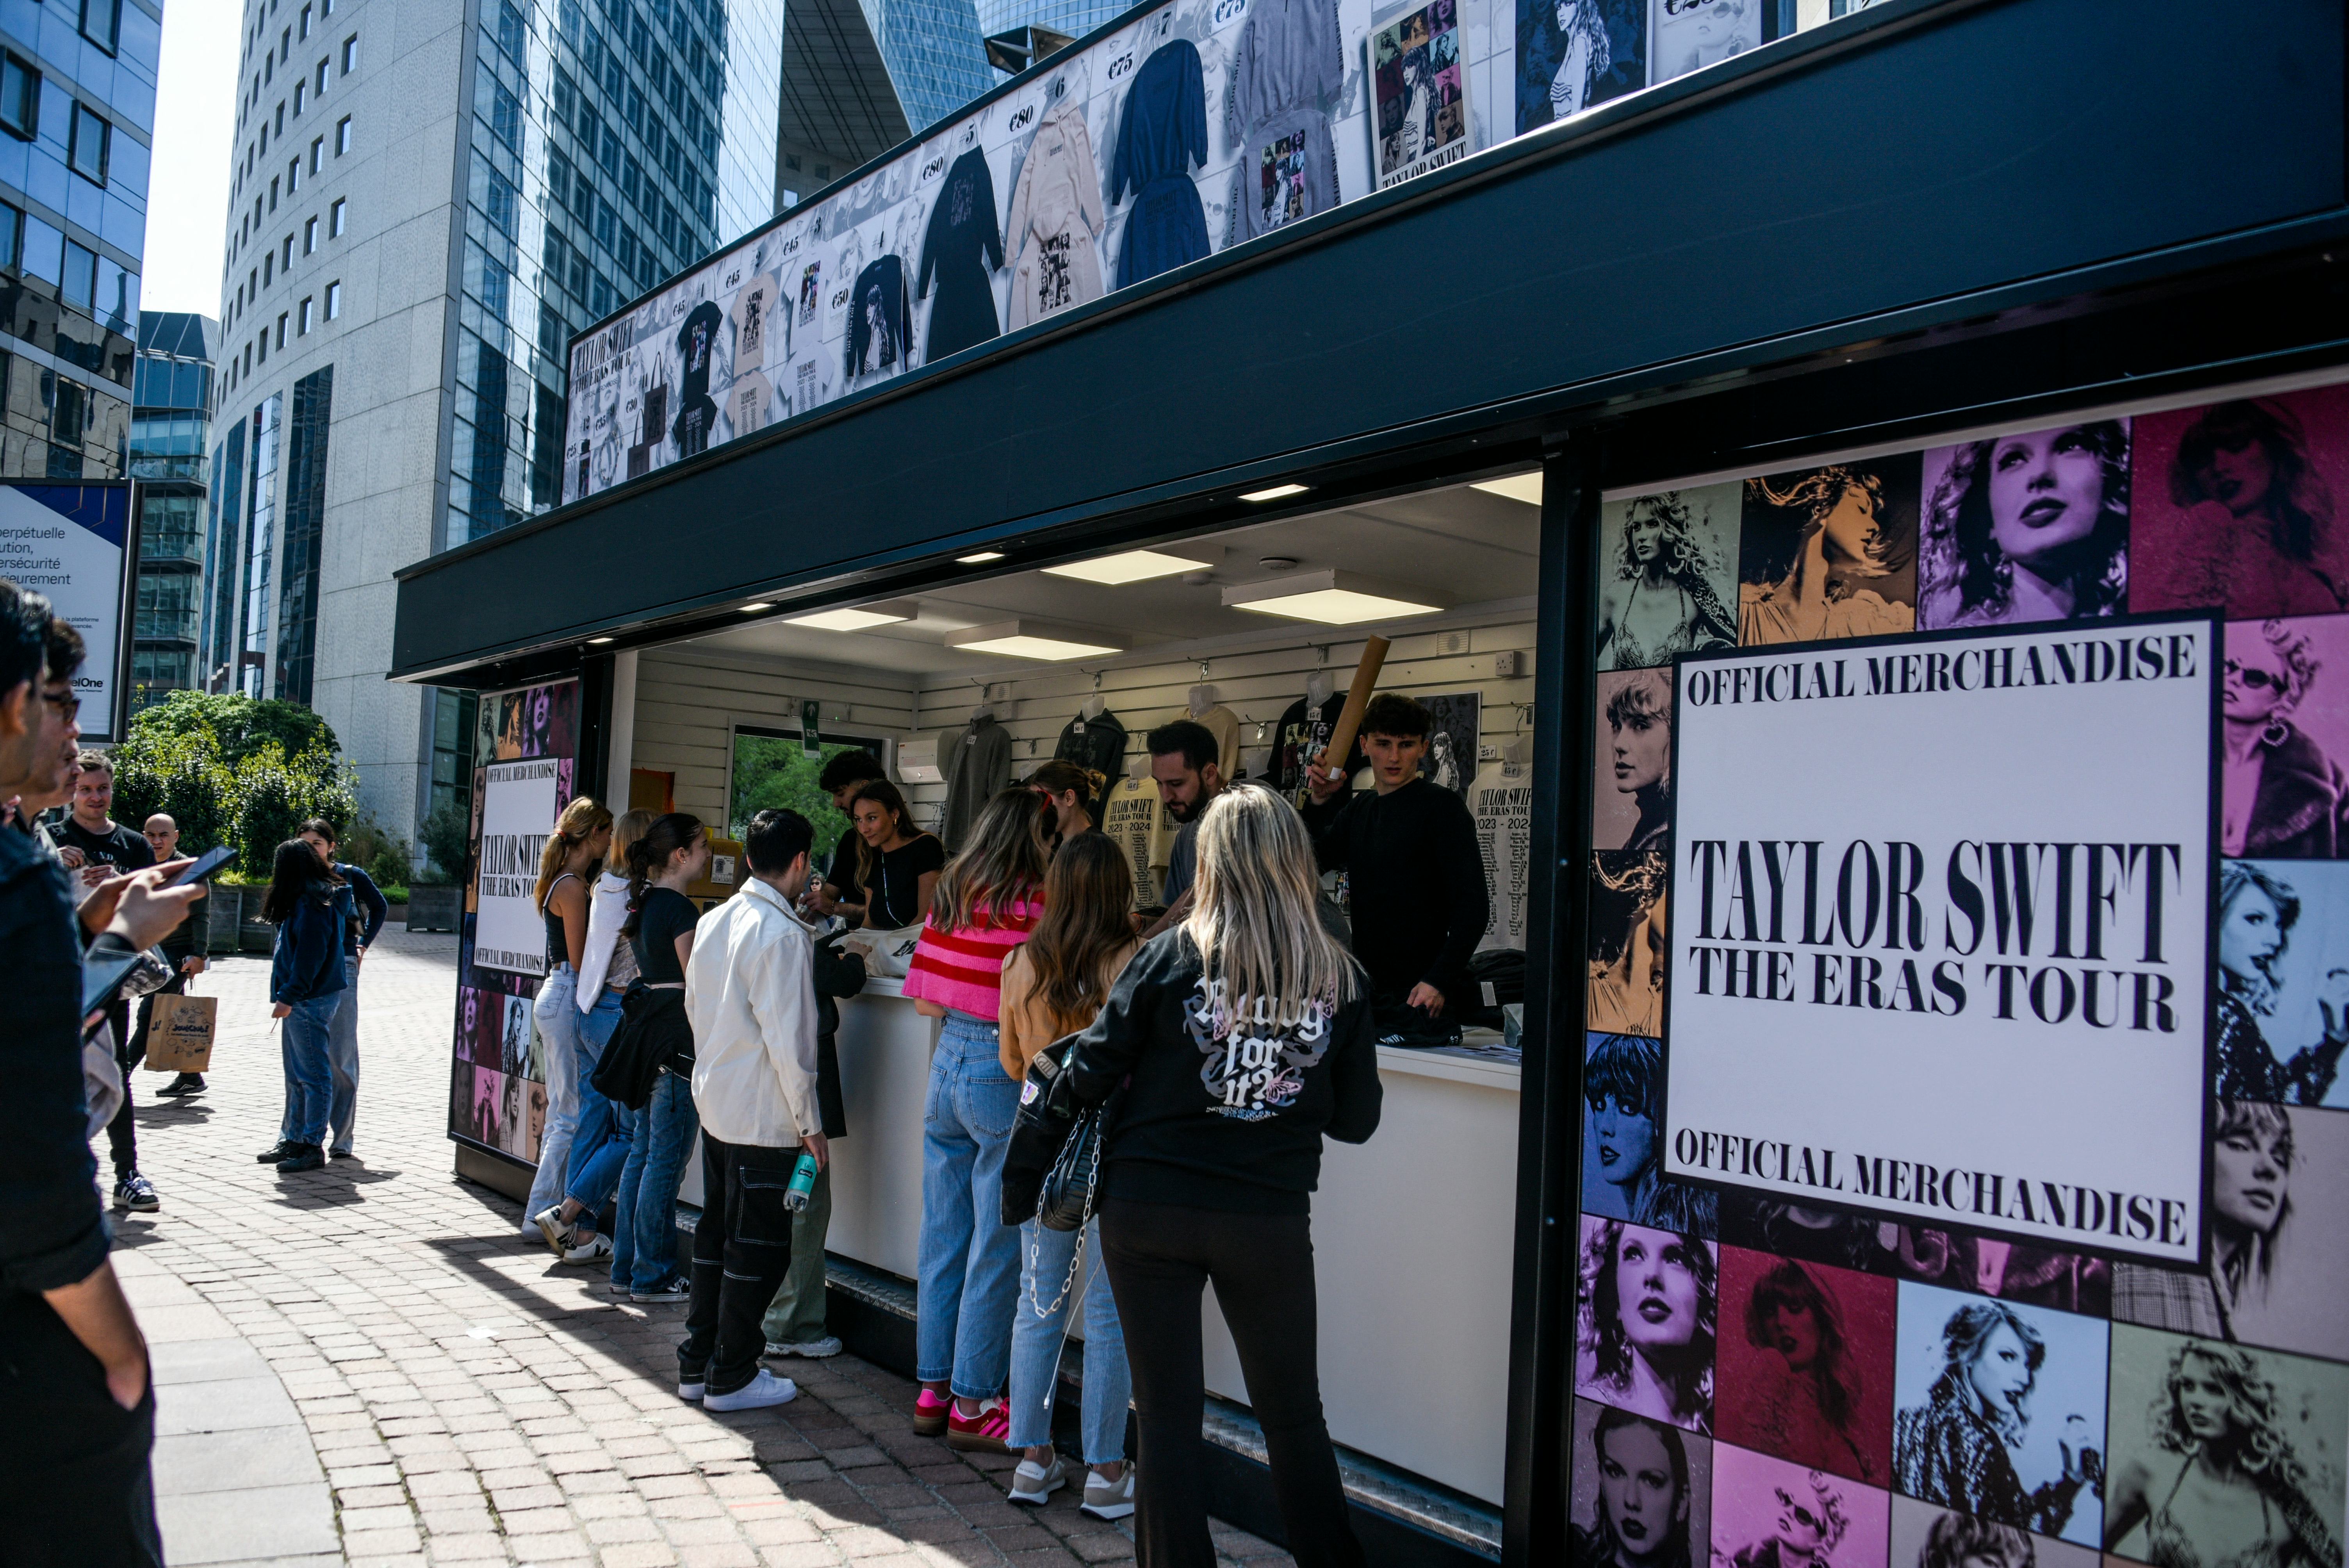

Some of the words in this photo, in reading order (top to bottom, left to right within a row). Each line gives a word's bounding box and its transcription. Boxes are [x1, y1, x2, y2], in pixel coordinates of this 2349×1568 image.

[1107, 51, 1133, 80] €75
[1047, 76, 1065, 102] #6
[1009, 105, 1034, 132] €80
[959, 123, 974, 148] #5
[923, 156, 943, 180] €80
[783, 235, 799, 256] €45
[726, 269, 740, 289] €45
[673, 299, 685, 317] €45
[831, 288, 849, 309] €50
[575, 333, 607, 377] TAYLOR
[607, 316, 635, 360] SWIFT
[575, 373, 589, 394] THE
[590, 365, 609, 386] ERAS
[610, 351, 631, 374] TOUR
[626, 397, 637, 413] €30
[595, 415, 606, 431] €35
[0, 542, 33, 555] ution,
[0, 557, 61, 569] ersécurité
[1688, 661, 1855, 706] OFFICIAL
[1863, 635, 2196, 697] MERCHANDISE
[487, 767, 512, 783] OFFICIAL
[512, 763, 556, 781] MERCHANDISE
[1129, 798, 1154, 813] SWIFT
[1508, 788, 1532, 806] SWIF
[1109, 814, 1117, 823] THE
[1118, 813, 1131, 821] ERAS
[1490, 806, 1510, 816] ERAS
[1512, 806, 1531, 816] TOU
[1108, 823, 1123, 833] 2023
[1130, 822, 1150, 831] 2024
[483, 834, 517, 875] TAYLOR
[482, 877, 497, 896] THE
[498, 877, 520, 898] ERAS
[522, 878, 539, 898] TO
[1691, 839, 1928, 951] TAYLOR
[1946, 839, 2180, 965] SWIFT
[476, 947, 500, 965] OFFICIAL
[500, 950, 544, 972] MERCHANDISE
[1690, 946, 1795, 1003] THE
[1807, 953, 1967, 1016] ERAS
[1985, 965, 2179, 1033] TOUR
[1223, 1023, 1283, 1077] for
[1223, 1068, 1274, 1110] it?
[1675, 1128, 1844, 1194] OFFICIAL
[1852, 1154, 2187, 1247] MERCHANDISE
